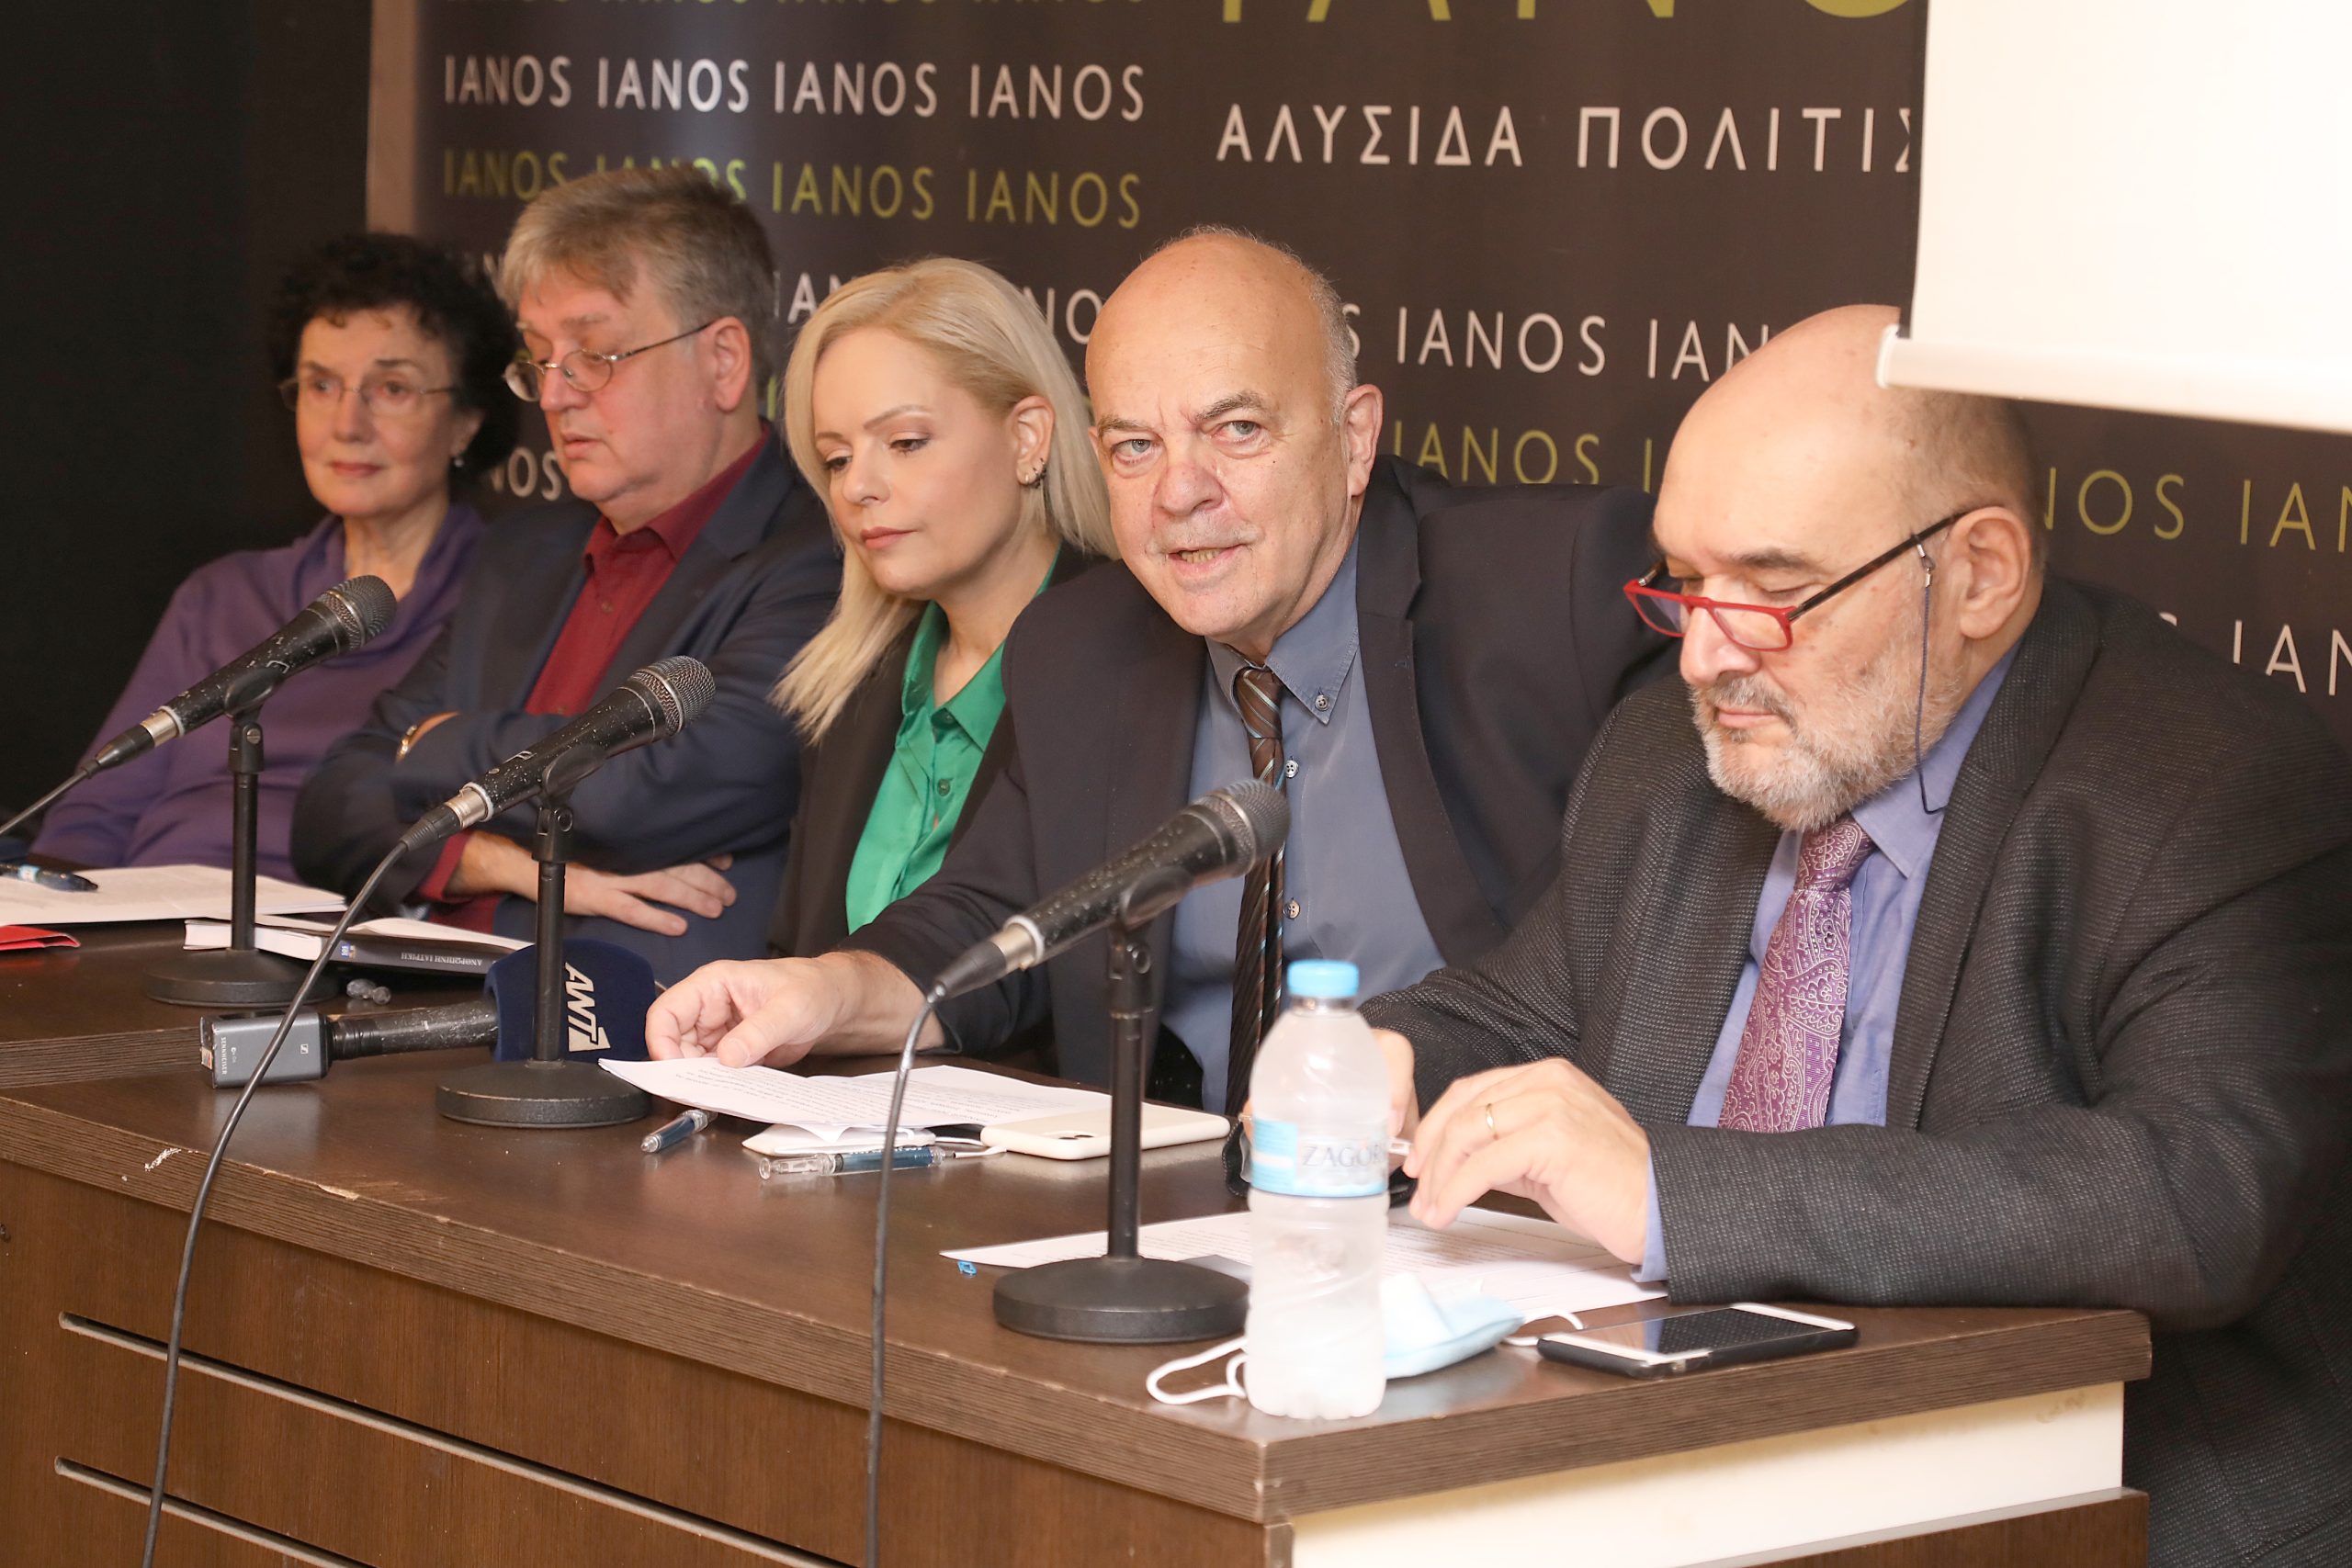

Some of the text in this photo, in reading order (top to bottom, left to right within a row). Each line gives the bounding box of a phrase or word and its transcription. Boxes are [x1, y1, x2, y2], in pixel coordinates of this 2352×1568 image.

[446, 55, 1144, 121] IANOS IANOS IANOS IANOS
[1216, 104, 1523, 166] ΑΛΥΣΙΔΑ
[772, 162, 933, 220] IANOS
[967, 169, 1140, 229] IANOS
[1397, 307, 1605, 377] IANOS
